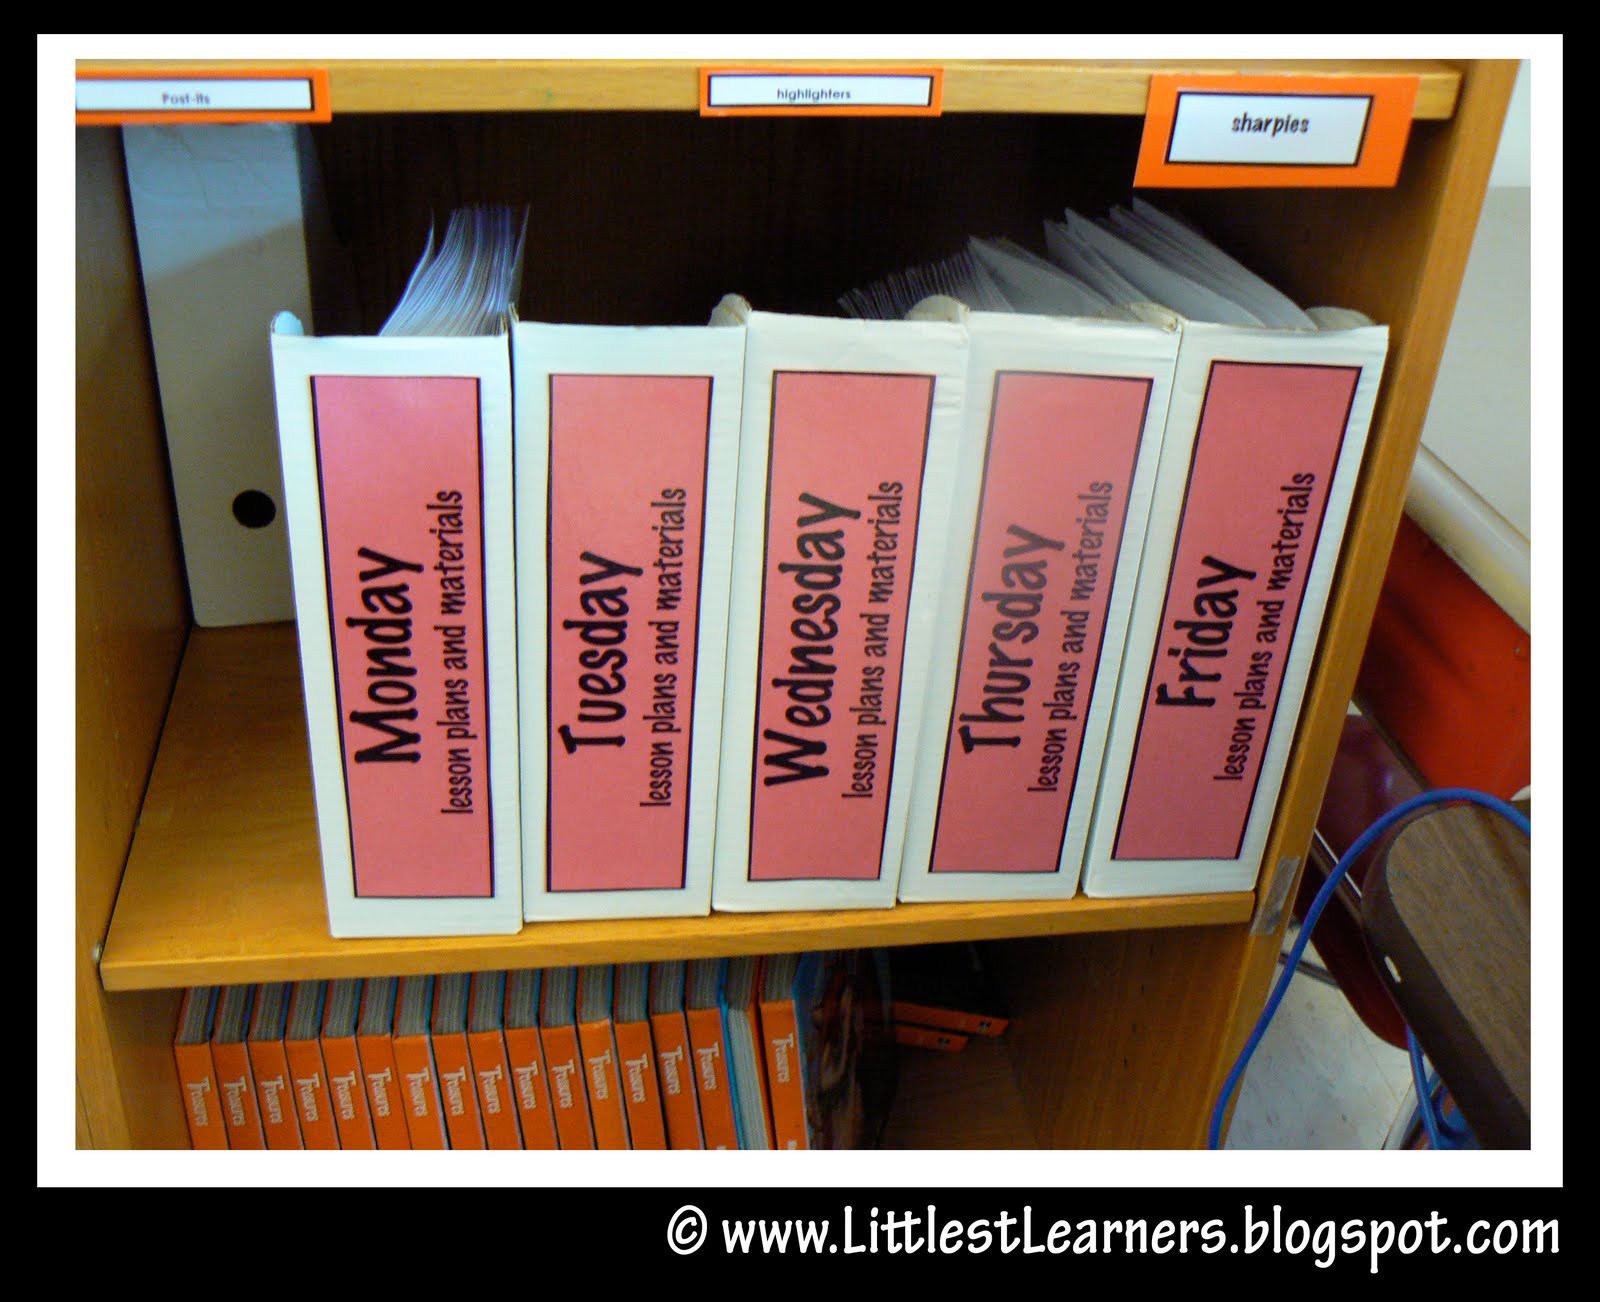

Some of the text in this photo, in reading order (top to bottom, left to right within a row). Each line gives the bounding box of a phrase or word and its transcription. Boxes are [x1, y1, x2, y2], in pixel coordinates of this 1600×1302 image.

[162, 93, 210, 105] Post-its
[1233, 114, 1308, 136] sharpies
[345, 547, 424, 763] Monday
[427, 491, 477, 814] lesson plans and materials
[558, 552, 643, 754] Tuesday
[640, 489, 686, 806] lesson plans and materials
[763, 492, 861, 787] Wednesday
[842, 482, 903, 798] lesson plans and materials
[958, 524, 1065, 754] Thursday
[1027, 480, 1113, 792] lesson plans and materials
[1155, 555, 1257, 708] Friday
[1213, 472, 1316, 781] lesson plans and materials
